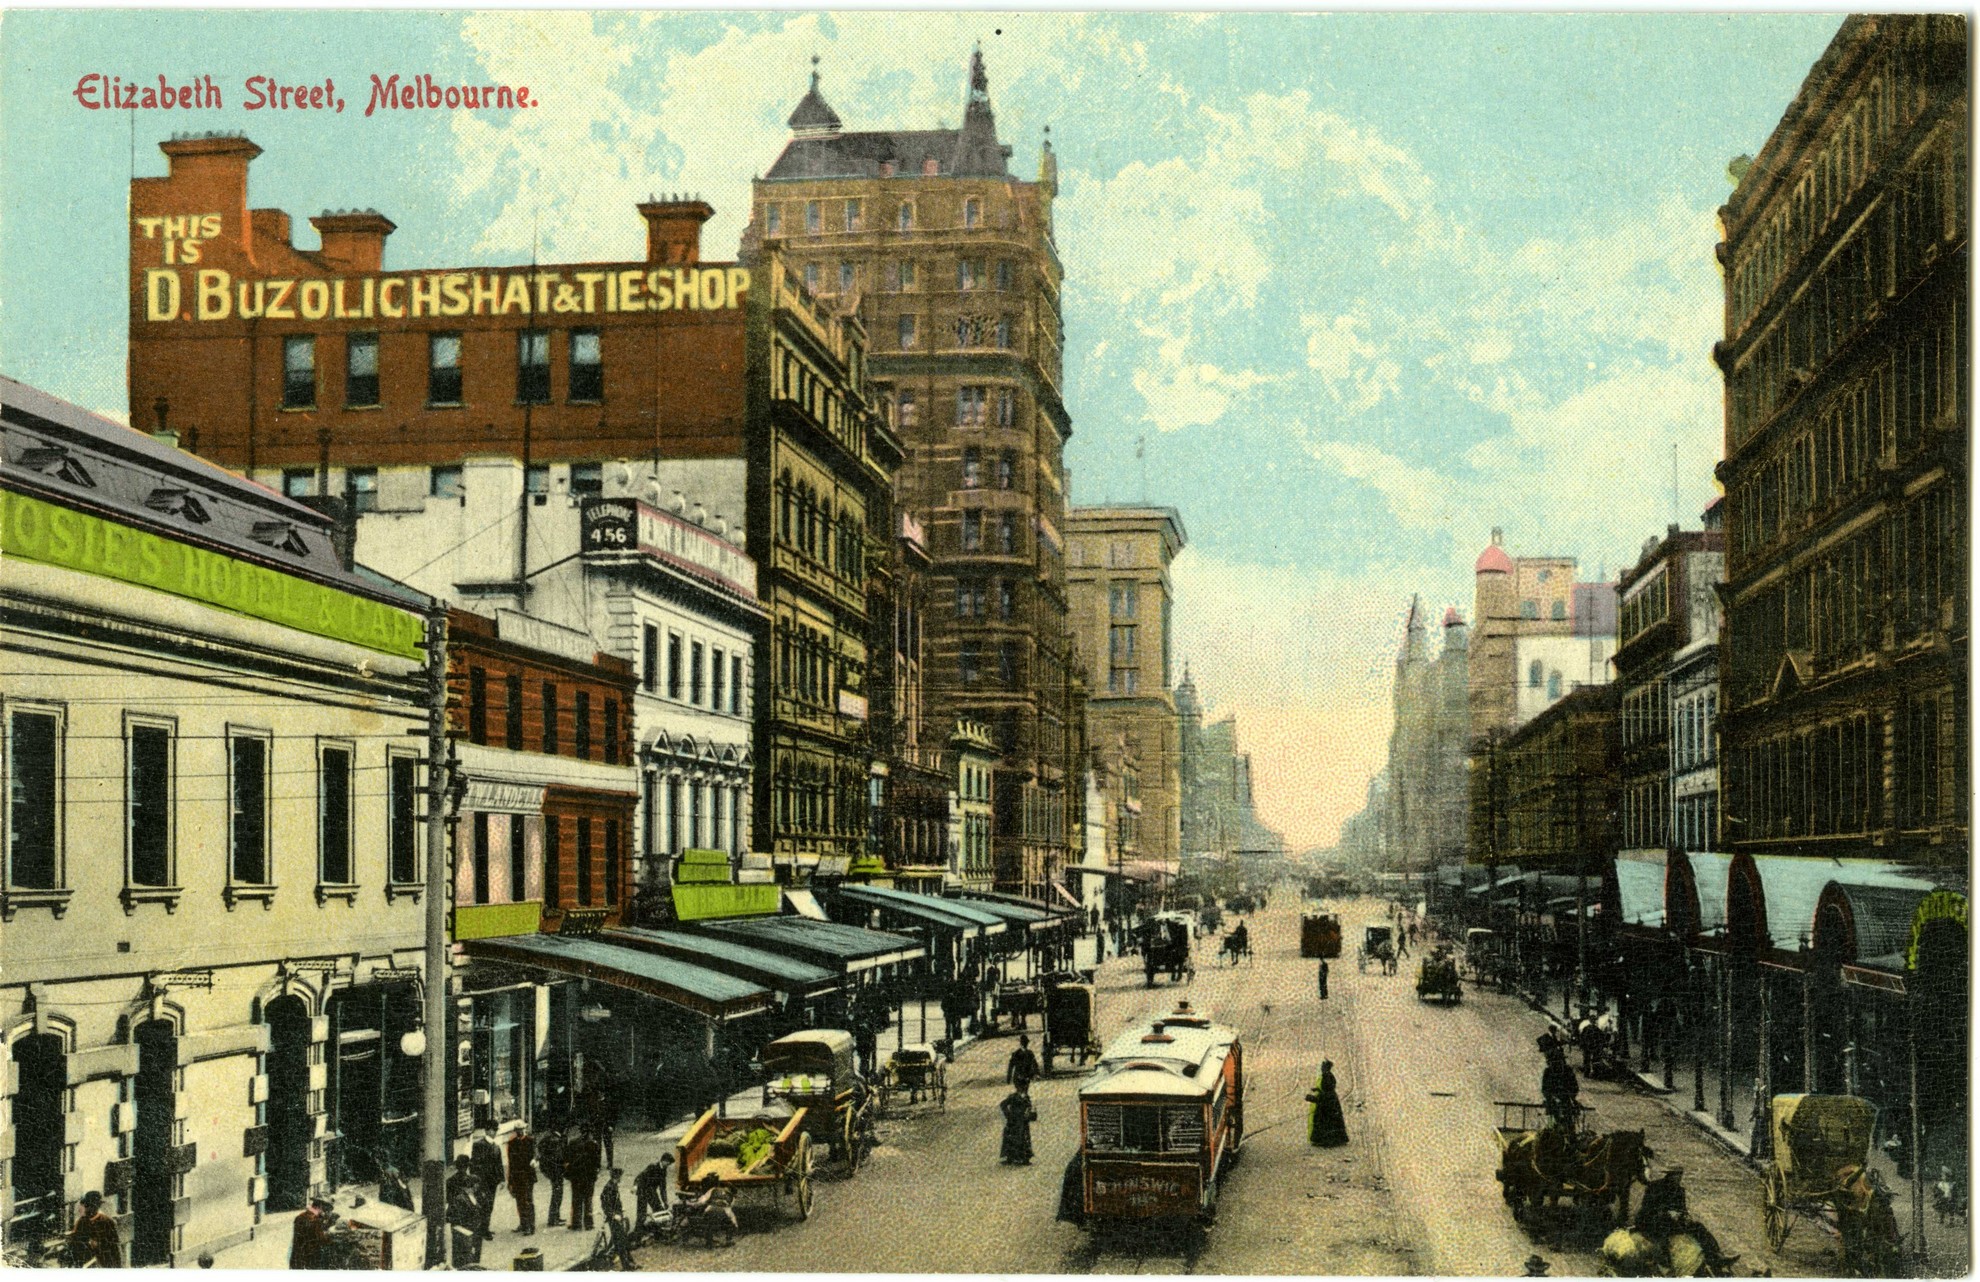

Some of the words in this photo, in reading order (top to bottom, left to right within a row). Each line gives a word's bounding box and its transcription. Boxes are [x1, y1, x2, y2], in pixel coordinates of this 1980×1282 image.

[137, 214, 222, 239] THIS
[164, 239, 202, 264] IS
[585, 502, 633, 522] TELEPHONE
[591, 527, 627, 543] 456
[181, 543, 304, 621] HOTEL
[318, 590, 340, 630] &
